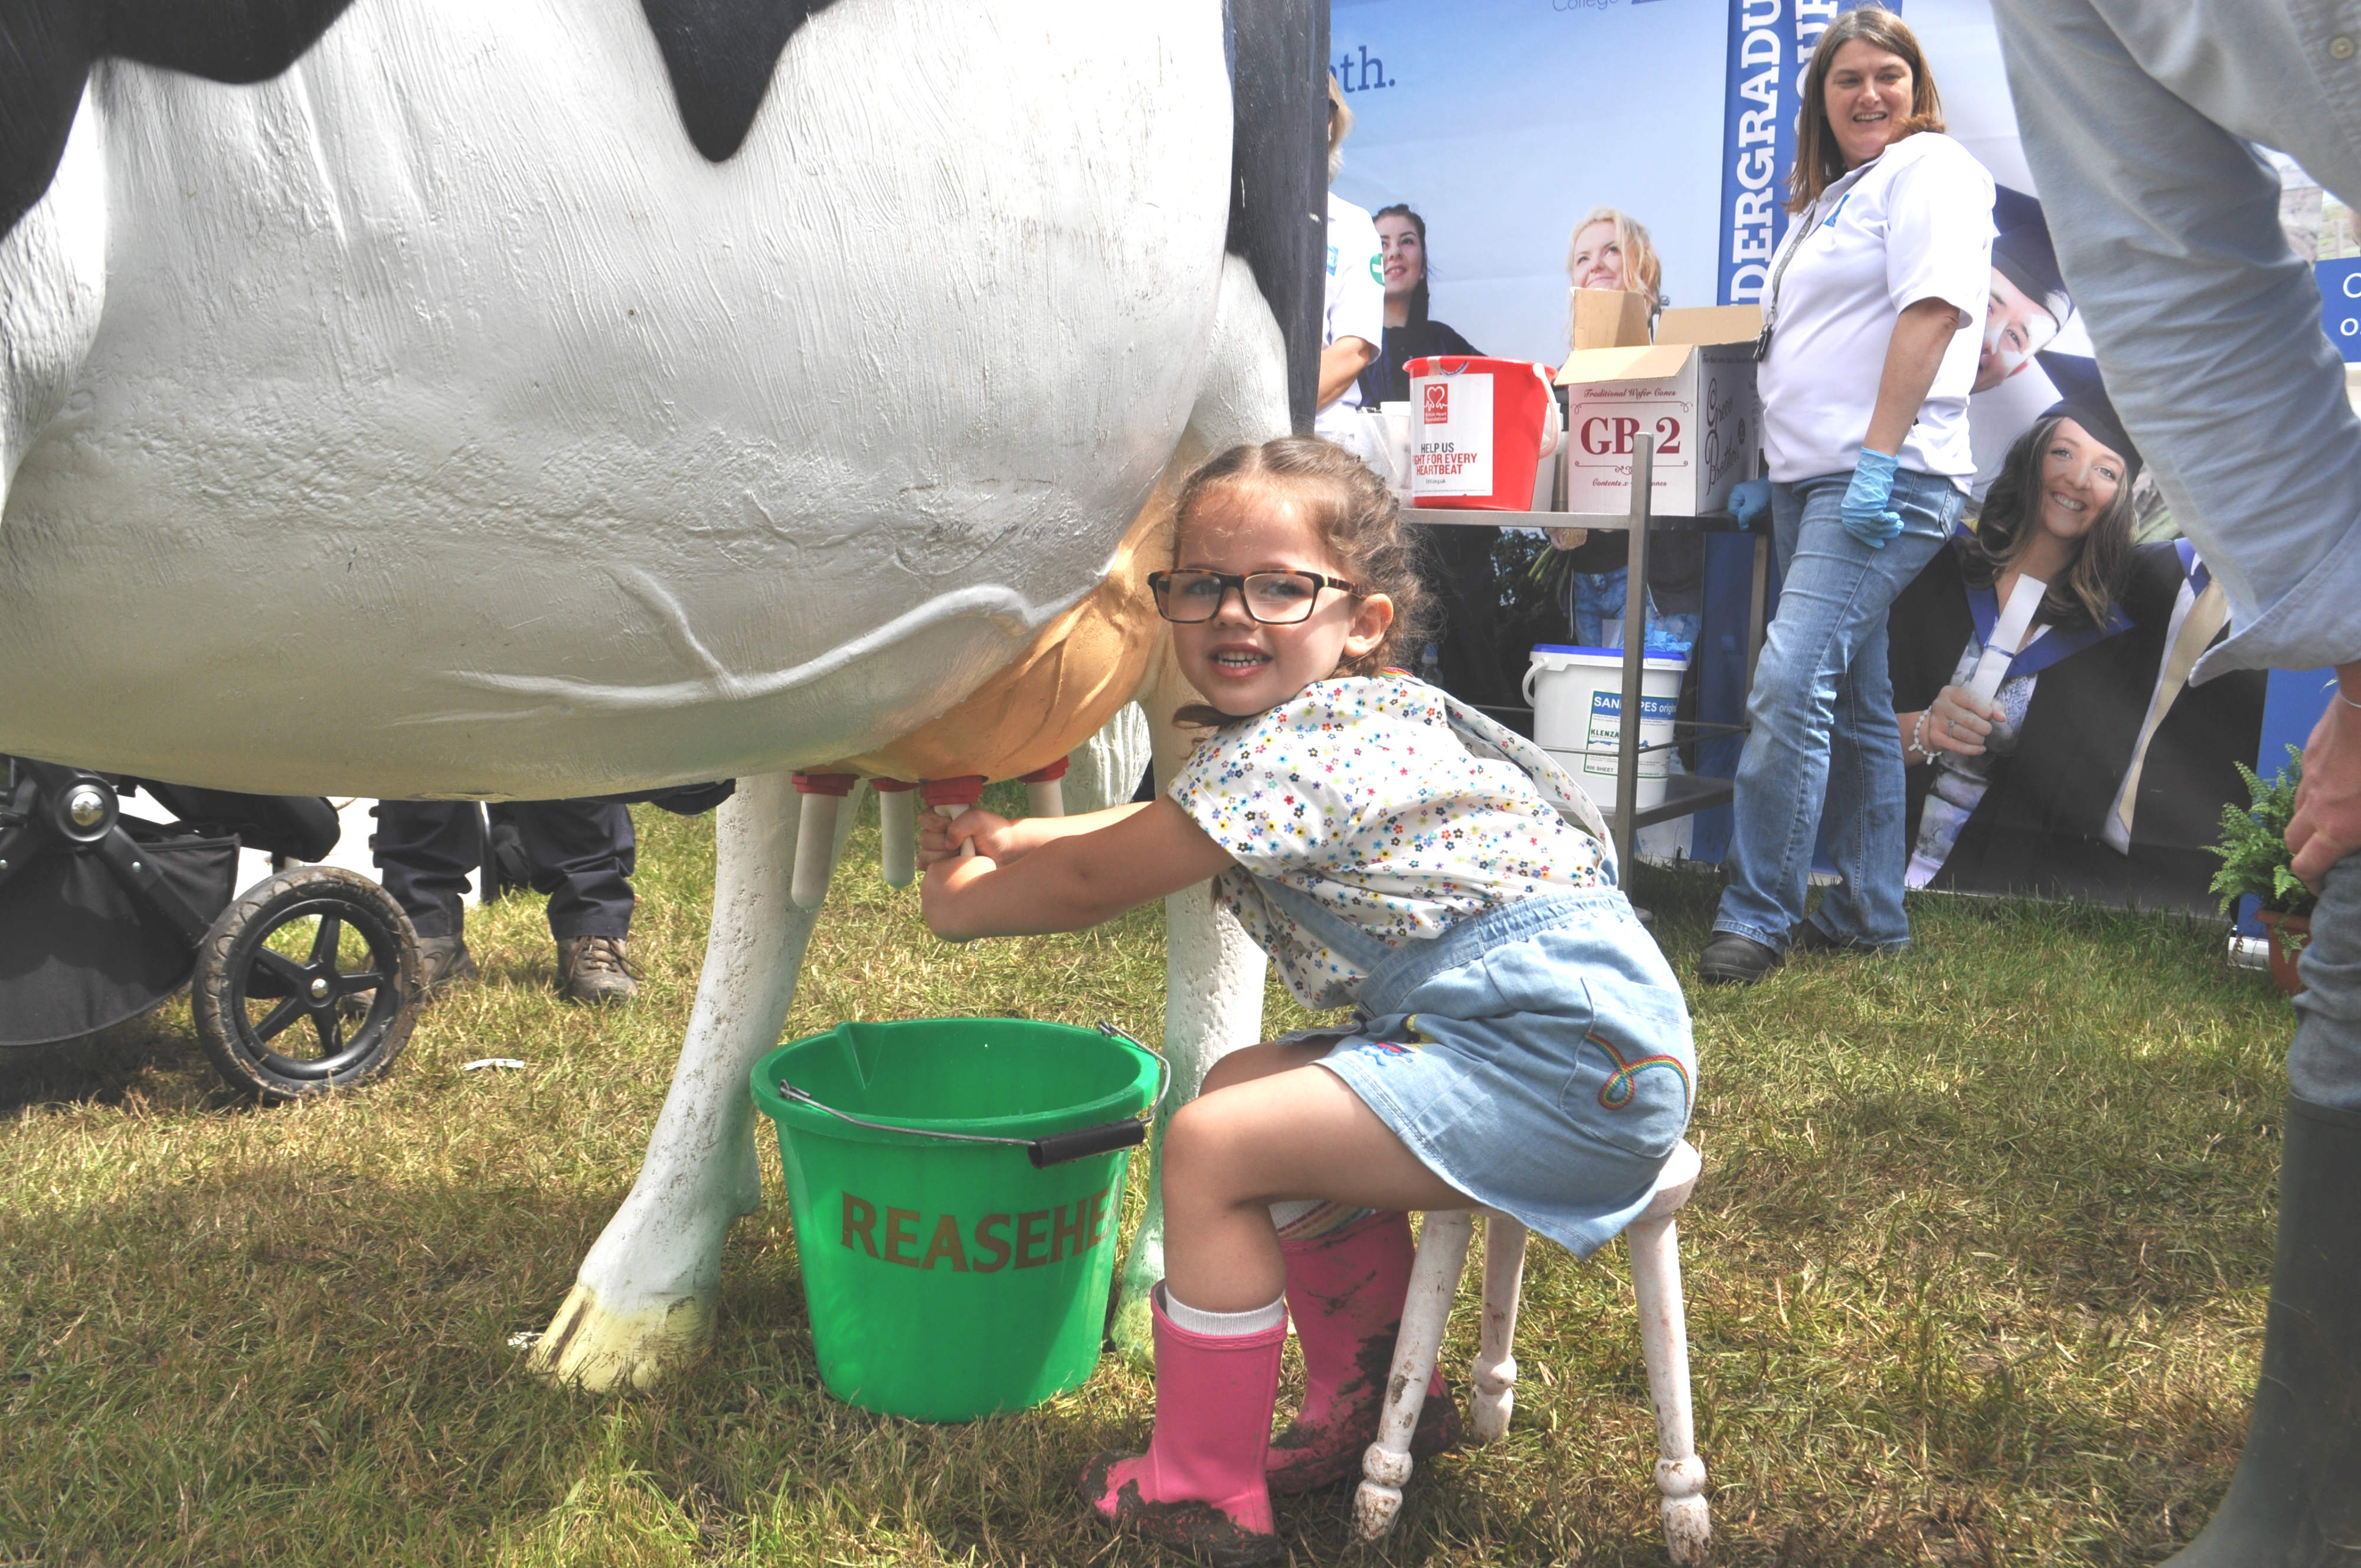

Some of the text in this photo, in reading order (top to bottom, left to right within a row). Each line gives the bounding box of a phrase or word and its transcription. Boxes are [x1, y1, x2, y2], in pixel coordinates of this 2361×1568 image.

[1731, 0, 1782, 305] DERGRADU
[1584, 387, 1677, 400] Traditional Wafer Cones
[1581, 417, 1681, 455] GB 2
[1421, 443, 1454, 453] HELP US
[1427, 454, 1443, 464] FOR
[1444, 453, 1478, 464] EVERY
[1417, 464, 1463, 476] HEARTBEAT
[1592, 478, 1621, 486] Contents
[841, 1185, 1119, 1273] REASEHE
